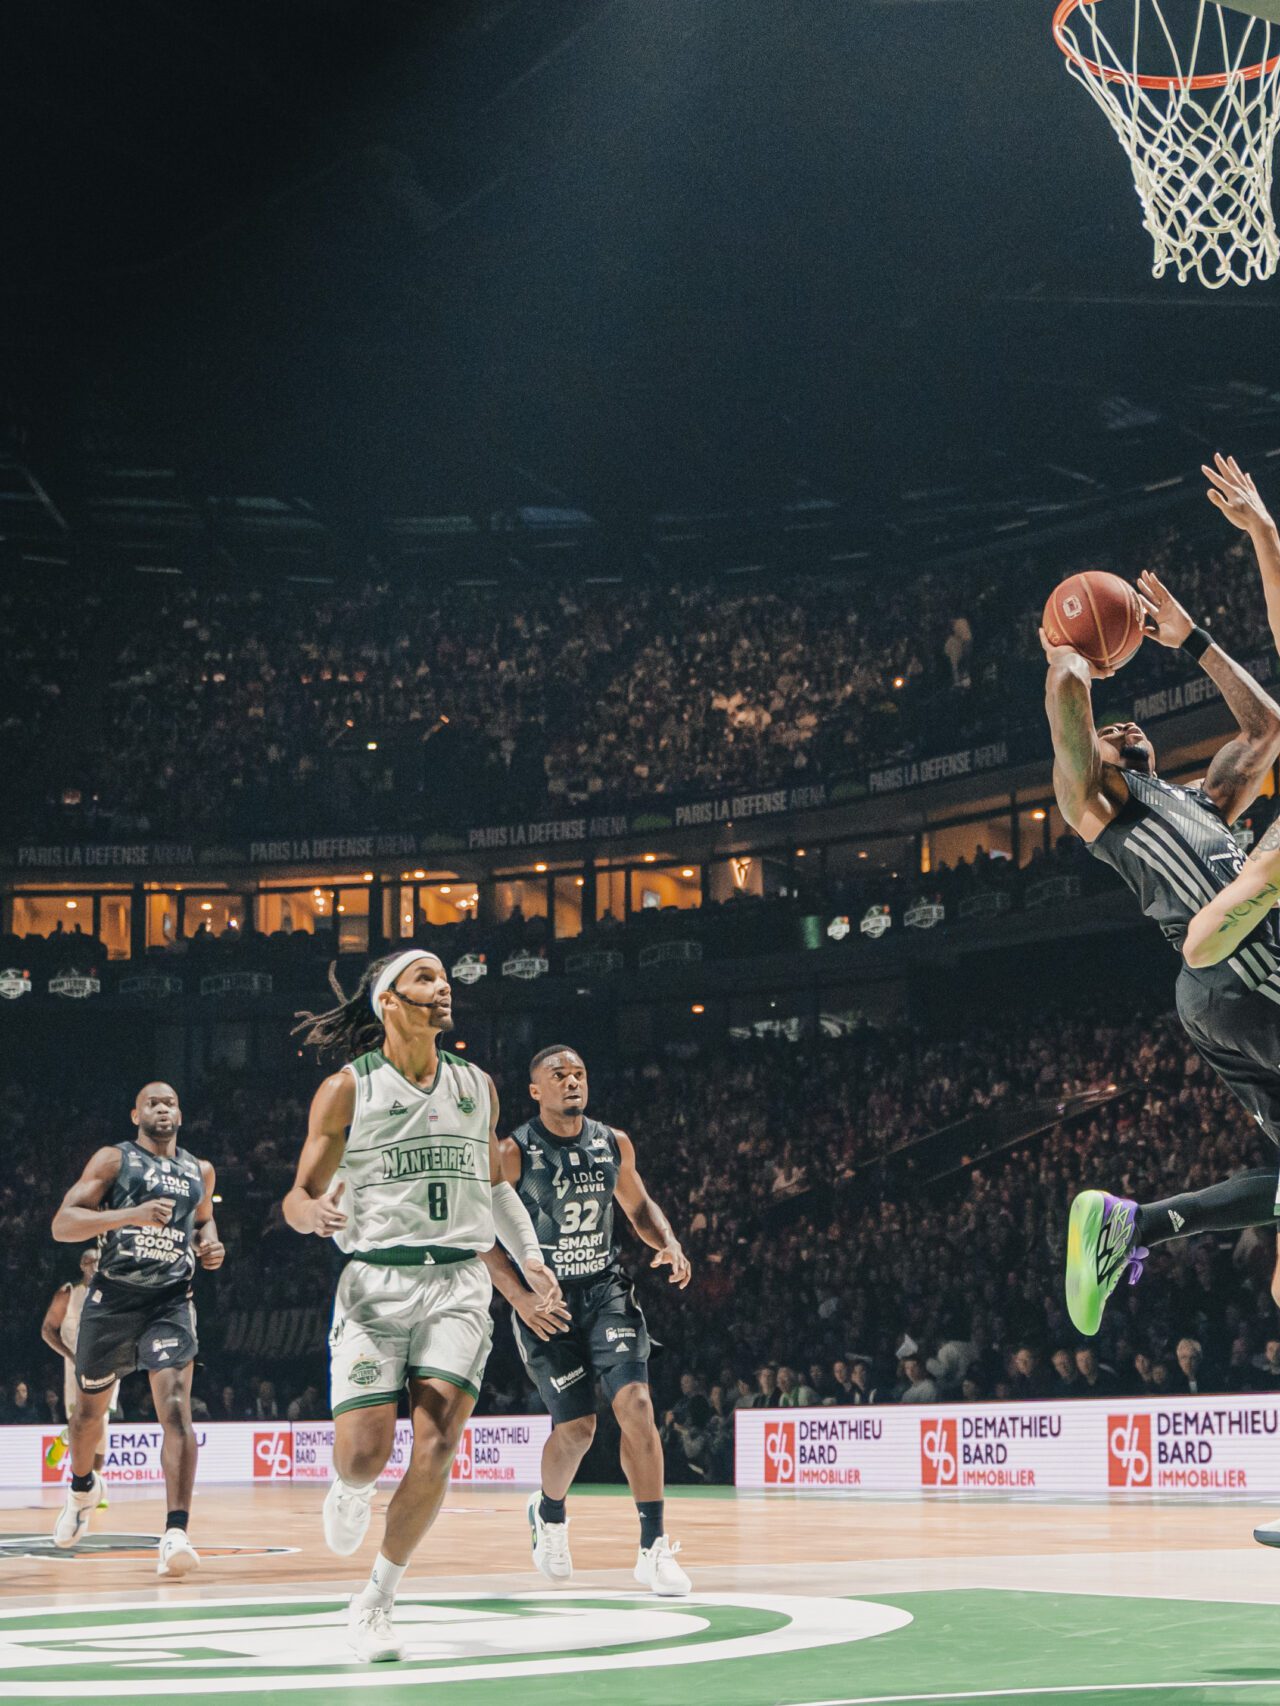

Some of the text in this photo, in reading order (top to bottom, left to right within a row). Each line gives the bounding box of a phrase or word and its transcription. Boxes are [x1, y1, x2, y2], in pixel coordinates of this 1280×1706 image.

[1169, 686, 1184, 711] LA
[870, 768, 903, 792] PARIS
[904, 763, 919, 785] LA
[920, 751, 972, 782] DEFENSE
[676, 802, 713, 826] PARIS
[714, 800, 730, 820] LA
[732, 790, 787, 819] DEFENSE
[469, 826, 508, 848] PARIS
[510, 825, 527, 845] LA
[529, 819, 587, 844] DEFENSE
[18, 846, 62, 865] PARIS
[64, 846, 81, 865] LA
[86, 845, 148, 866] DEFENSE
[251, 841, 290, 861] PARIS
[293, 840, 310, 860] LA
[313, 837, 373, 859] DEFENSE
[161, 1175, 190, 1190] LDLC
[572, 1171, 605, 1184] LDLC
[575, 1183, 606, 1194] ASVEL
[428, 1182, 448, 1221] 8
[560, 1200, 600, 1234] 32
[134, 1234, 174, 1251] GOOD
[142, 1225, 186, 1242] SMART
[558, 1233, 604, 1250] SMART
[135, 1246, 180, 1264] THINGS
[552, 1248, 596, 1263] GOOD
[555, 1258, 606, 1277] THINGS
[799, 1419, 882, 1441] DEMATHIEU
[961, 1415, 1062, 1439] DEMATHIEU
[1157, 1410, 1278, 1436] DEMATHIEU
[110, 1432, 207, 1449] EMATU
[296, 1431, 334, 1446] DEMATHIE
[474, 1427, 530, 1444] DEMATHIEU
[106, 1452, 147, 1466] ARD
[296, 1449, 316, 1463] BARD
[474, 1448, 500, 1464] BARD
[799, 1445, 837, 1464] BARD
[962, 1443, 1007, 1465] BARD
[1158, 1441, 1212, 1464] BARD
[475, 1468, 515, 1480] IMMOBILIER
[799, 1468, 861, 1484] IMMOBILIER
[963, 1469, 1035, 1486] IMMOBILIER
[1158, 1469, 1247, 1488] IMMOBILIER
